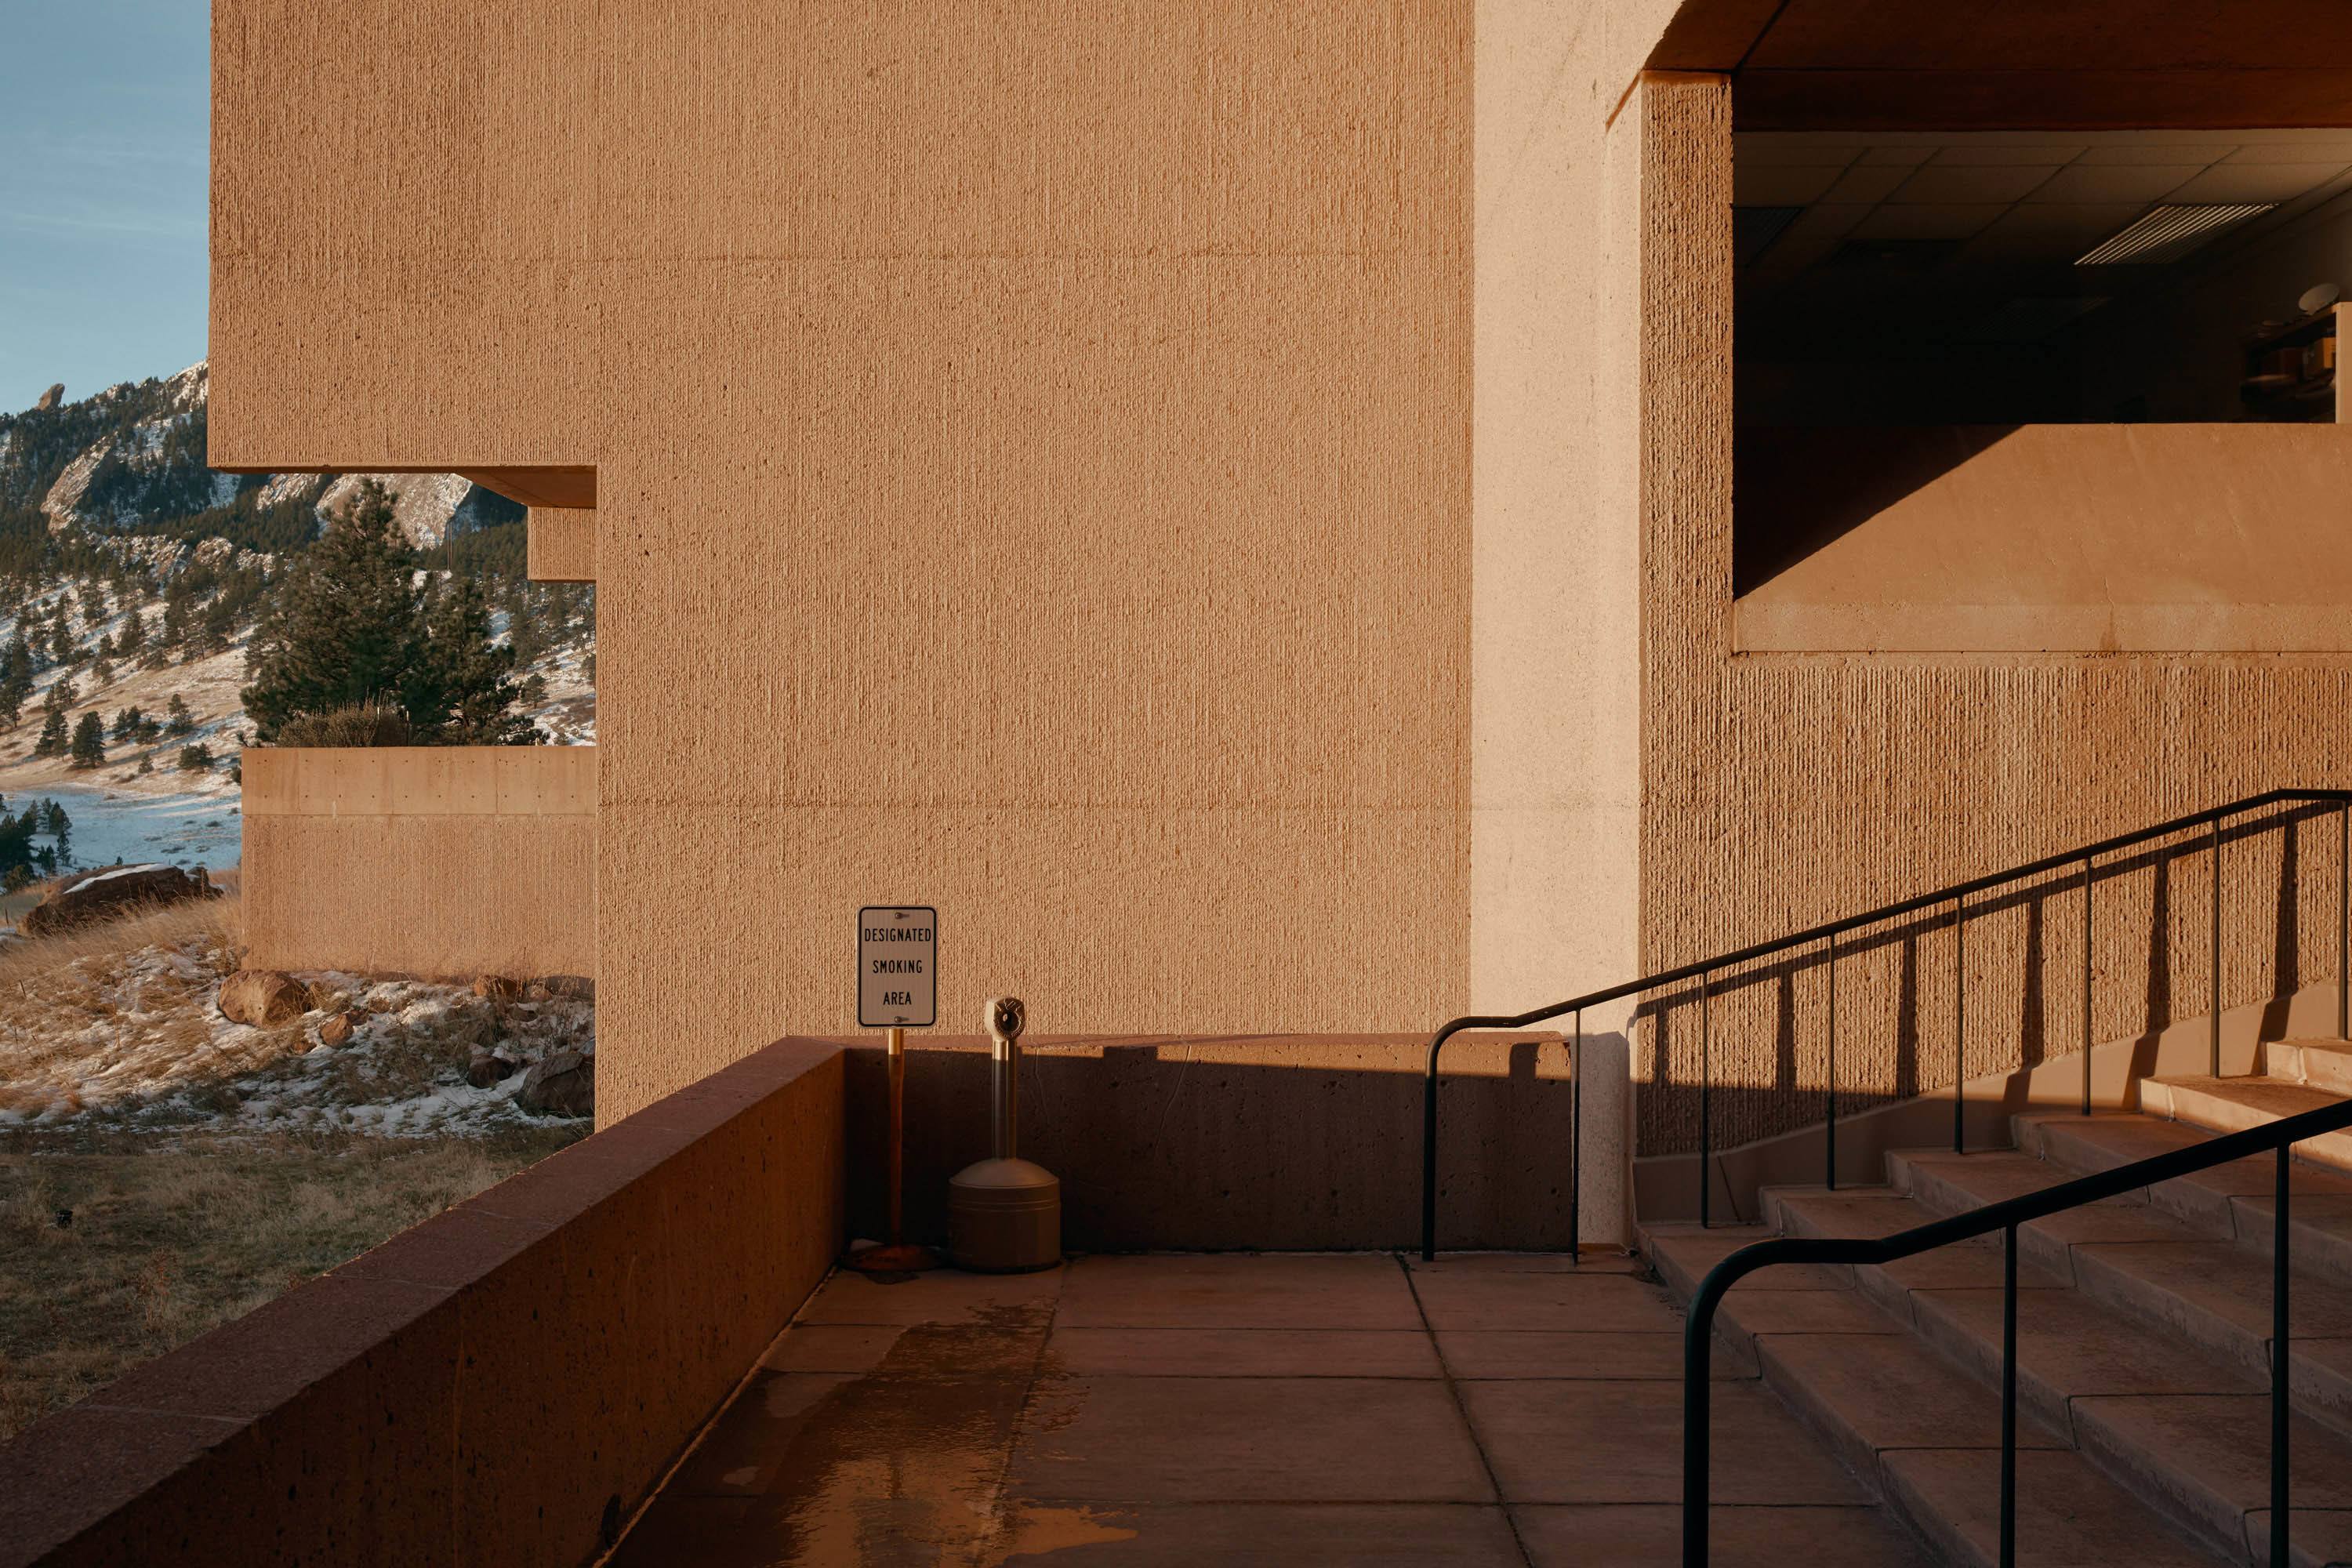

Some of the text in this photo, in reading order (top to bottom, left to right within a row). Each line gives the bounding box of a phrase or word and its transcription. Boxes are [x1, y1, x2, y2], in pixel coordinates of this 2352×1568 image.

[865, 928, 931, 942] DESIGNATED
[873, 960, 922, 974] SMOKING
[883, 992, 912, 1005] AREA
